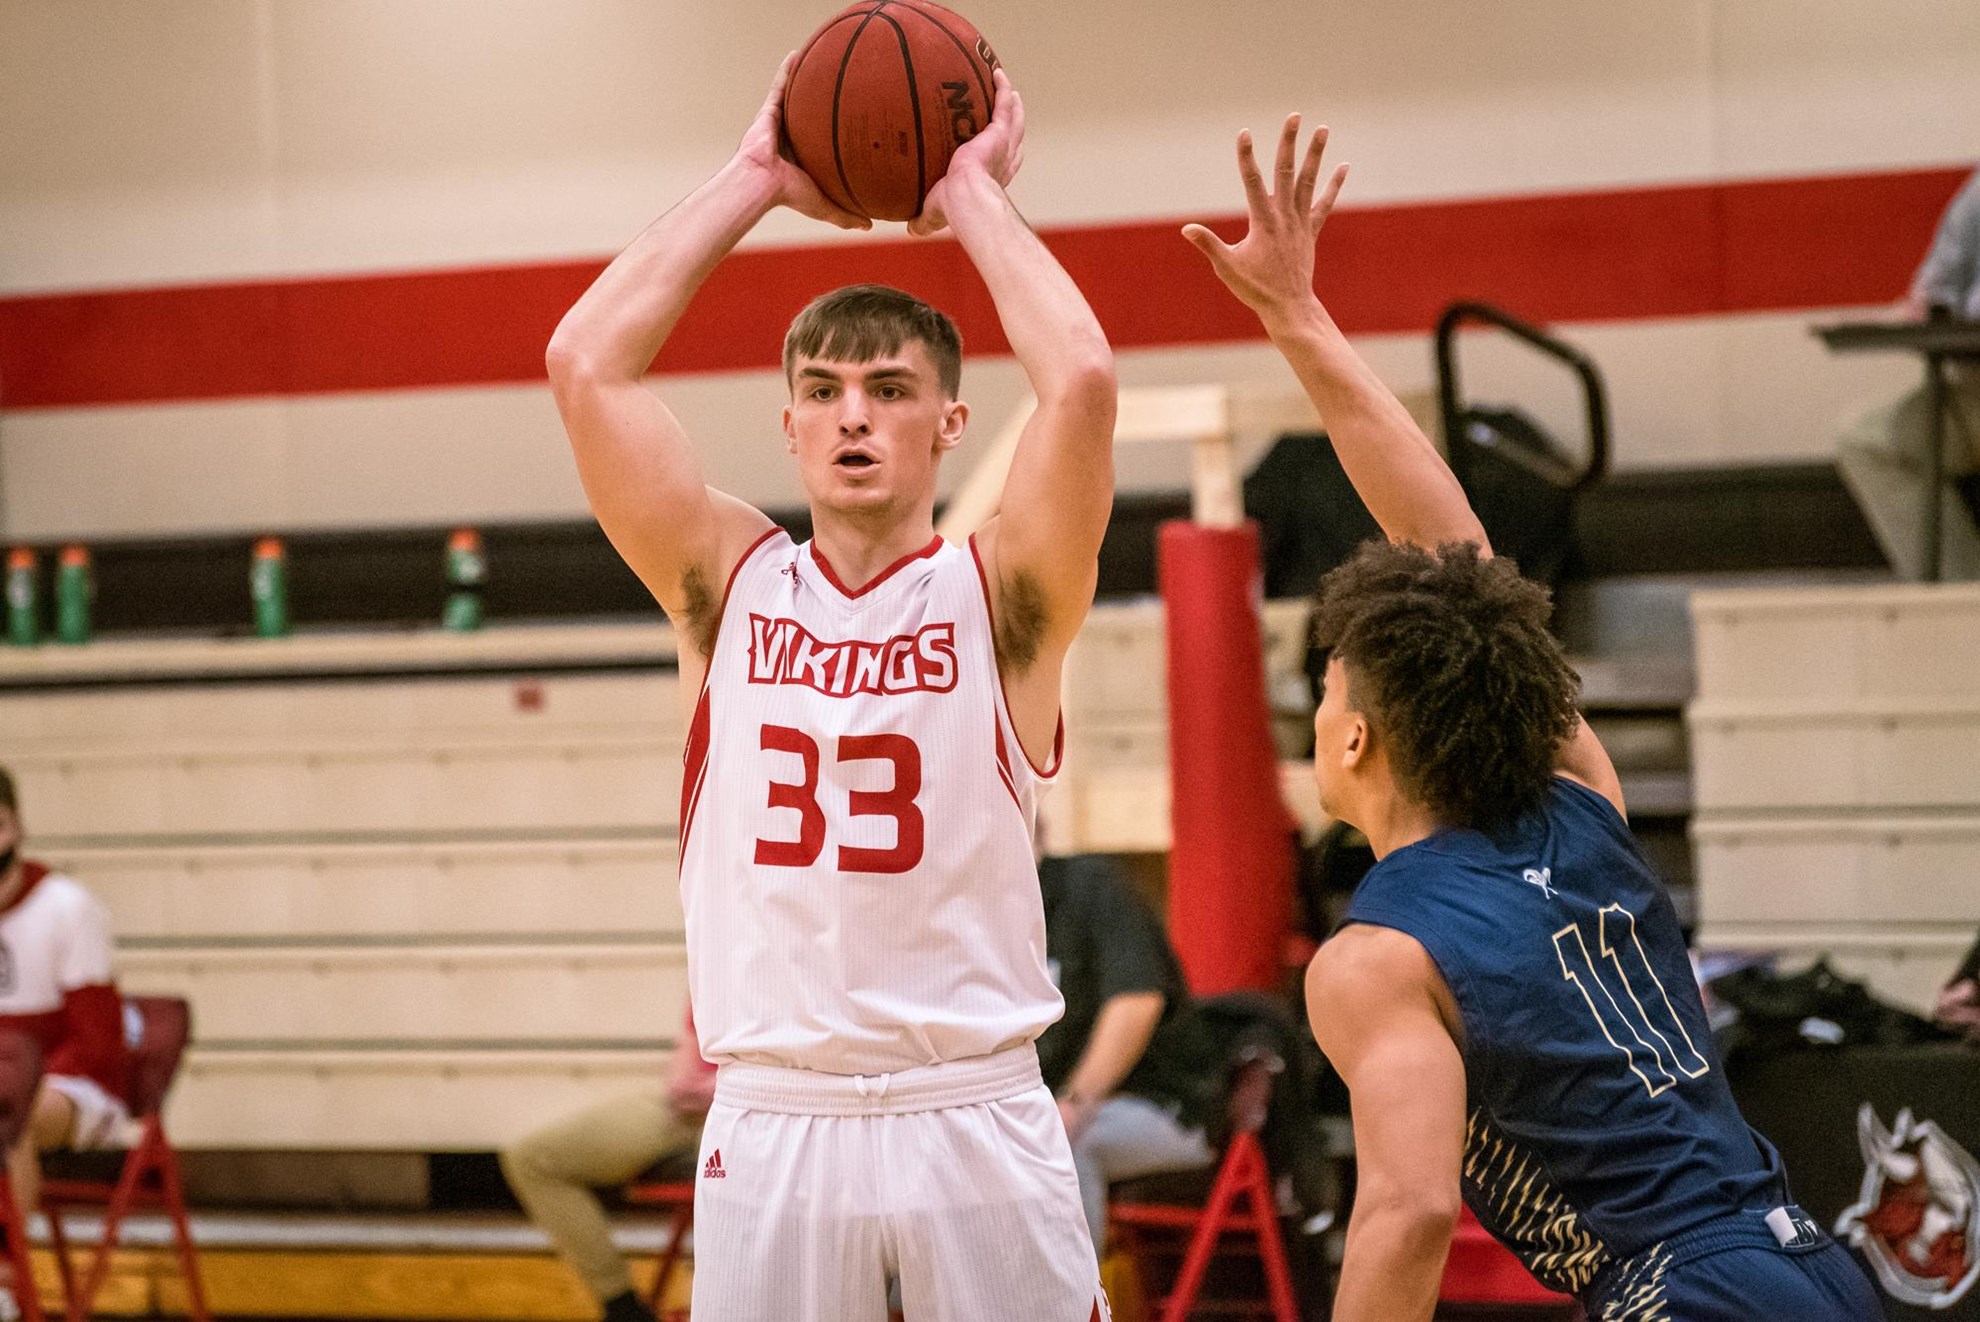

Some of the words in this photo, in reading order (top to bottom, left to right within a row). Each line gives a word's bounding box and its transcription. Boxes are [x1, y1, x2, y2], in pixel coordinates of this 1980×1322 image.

[941, 81, 978, 145] NC
[747, 612, 959, 699] VIKINGS
[754, 723, 925, 874] 33
[1552, 902, 1710, 1098] 11
